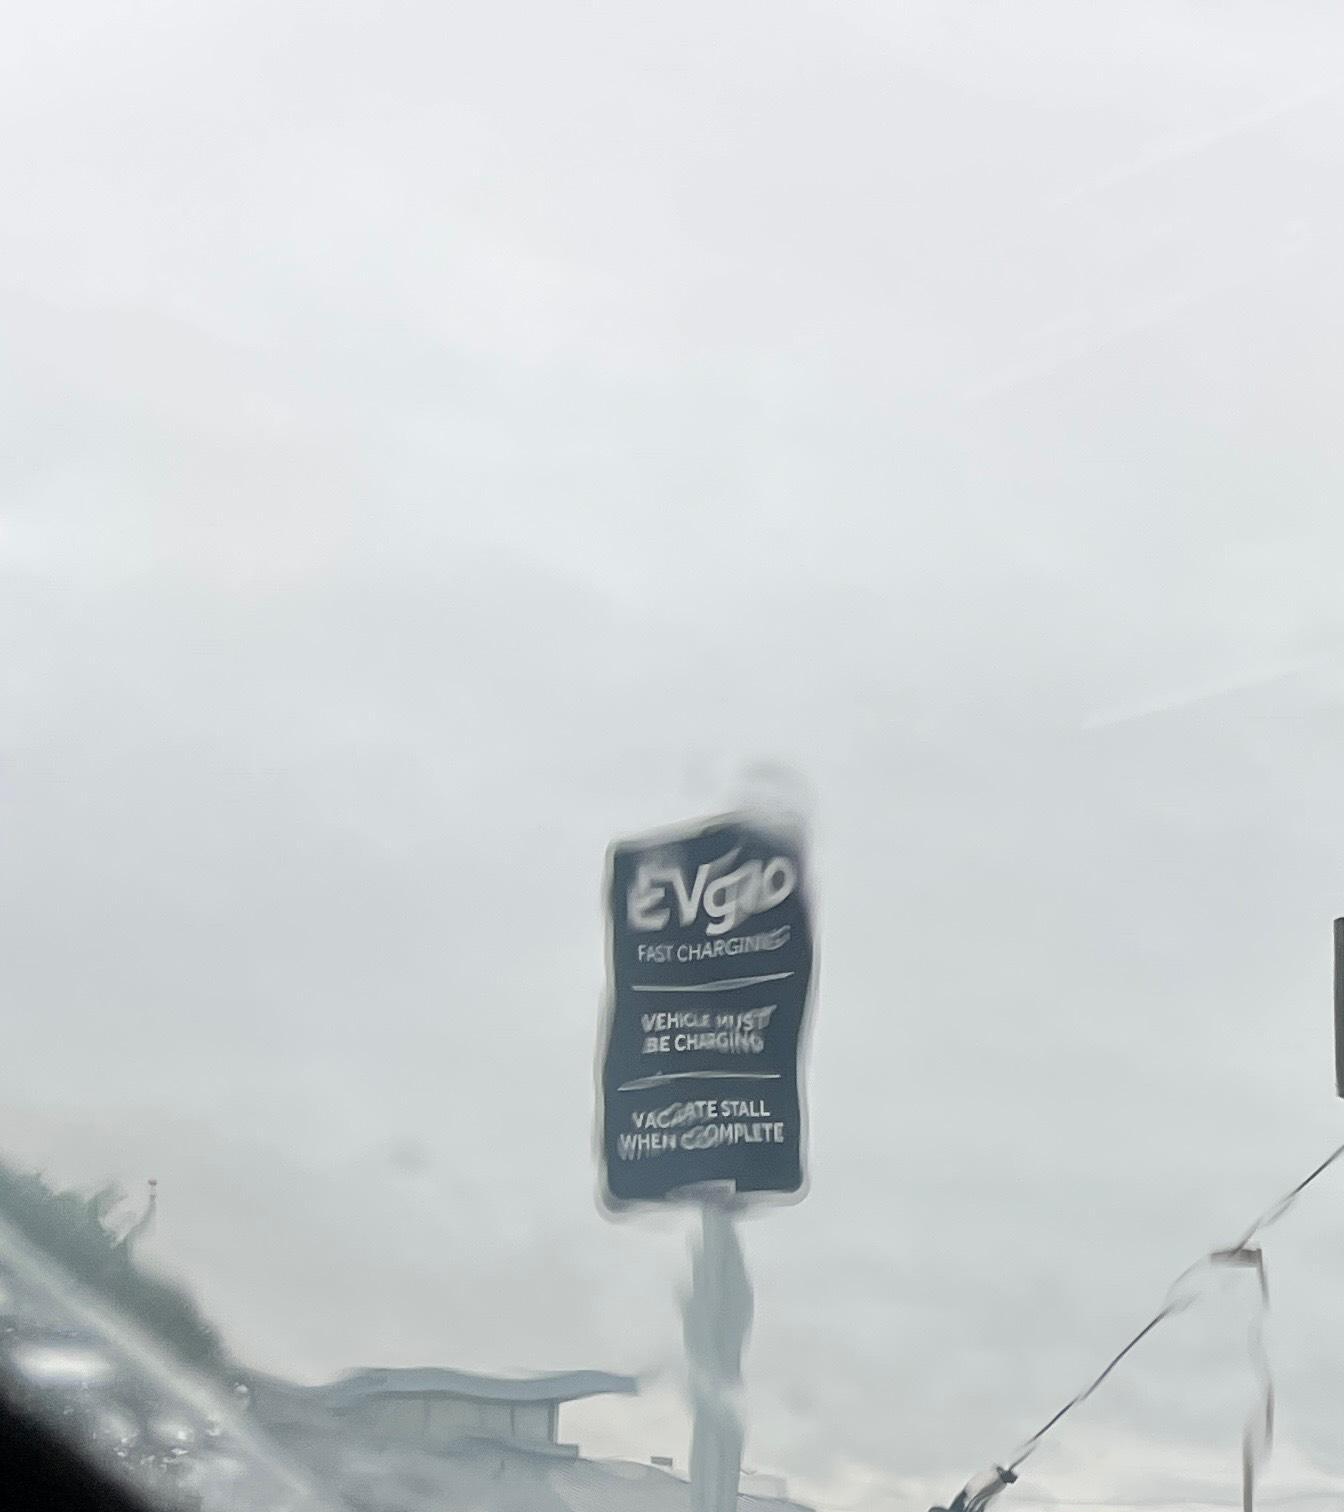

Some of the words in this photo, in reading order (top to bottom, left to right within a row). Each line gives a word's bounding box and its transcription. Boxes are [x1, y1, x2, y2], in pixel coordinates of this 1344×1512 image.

[626, 847, 797, 936] EVgo
[638, 944, 673, 963] FAST
[676, 925, 791, 963] CHARGING
[641, 1011, 711, 1033] VEHICLE
[716, 1005, 777, 1031] MUST
[643, 1035, 671, 1054] BE
[675, 1032, 765, 1054] CHARGING
[721, 1100, 770, 1117] STALL
[617, 1133, 677, 1160] WHEN
[680, 1122, 784, 1150] COMPLETE
